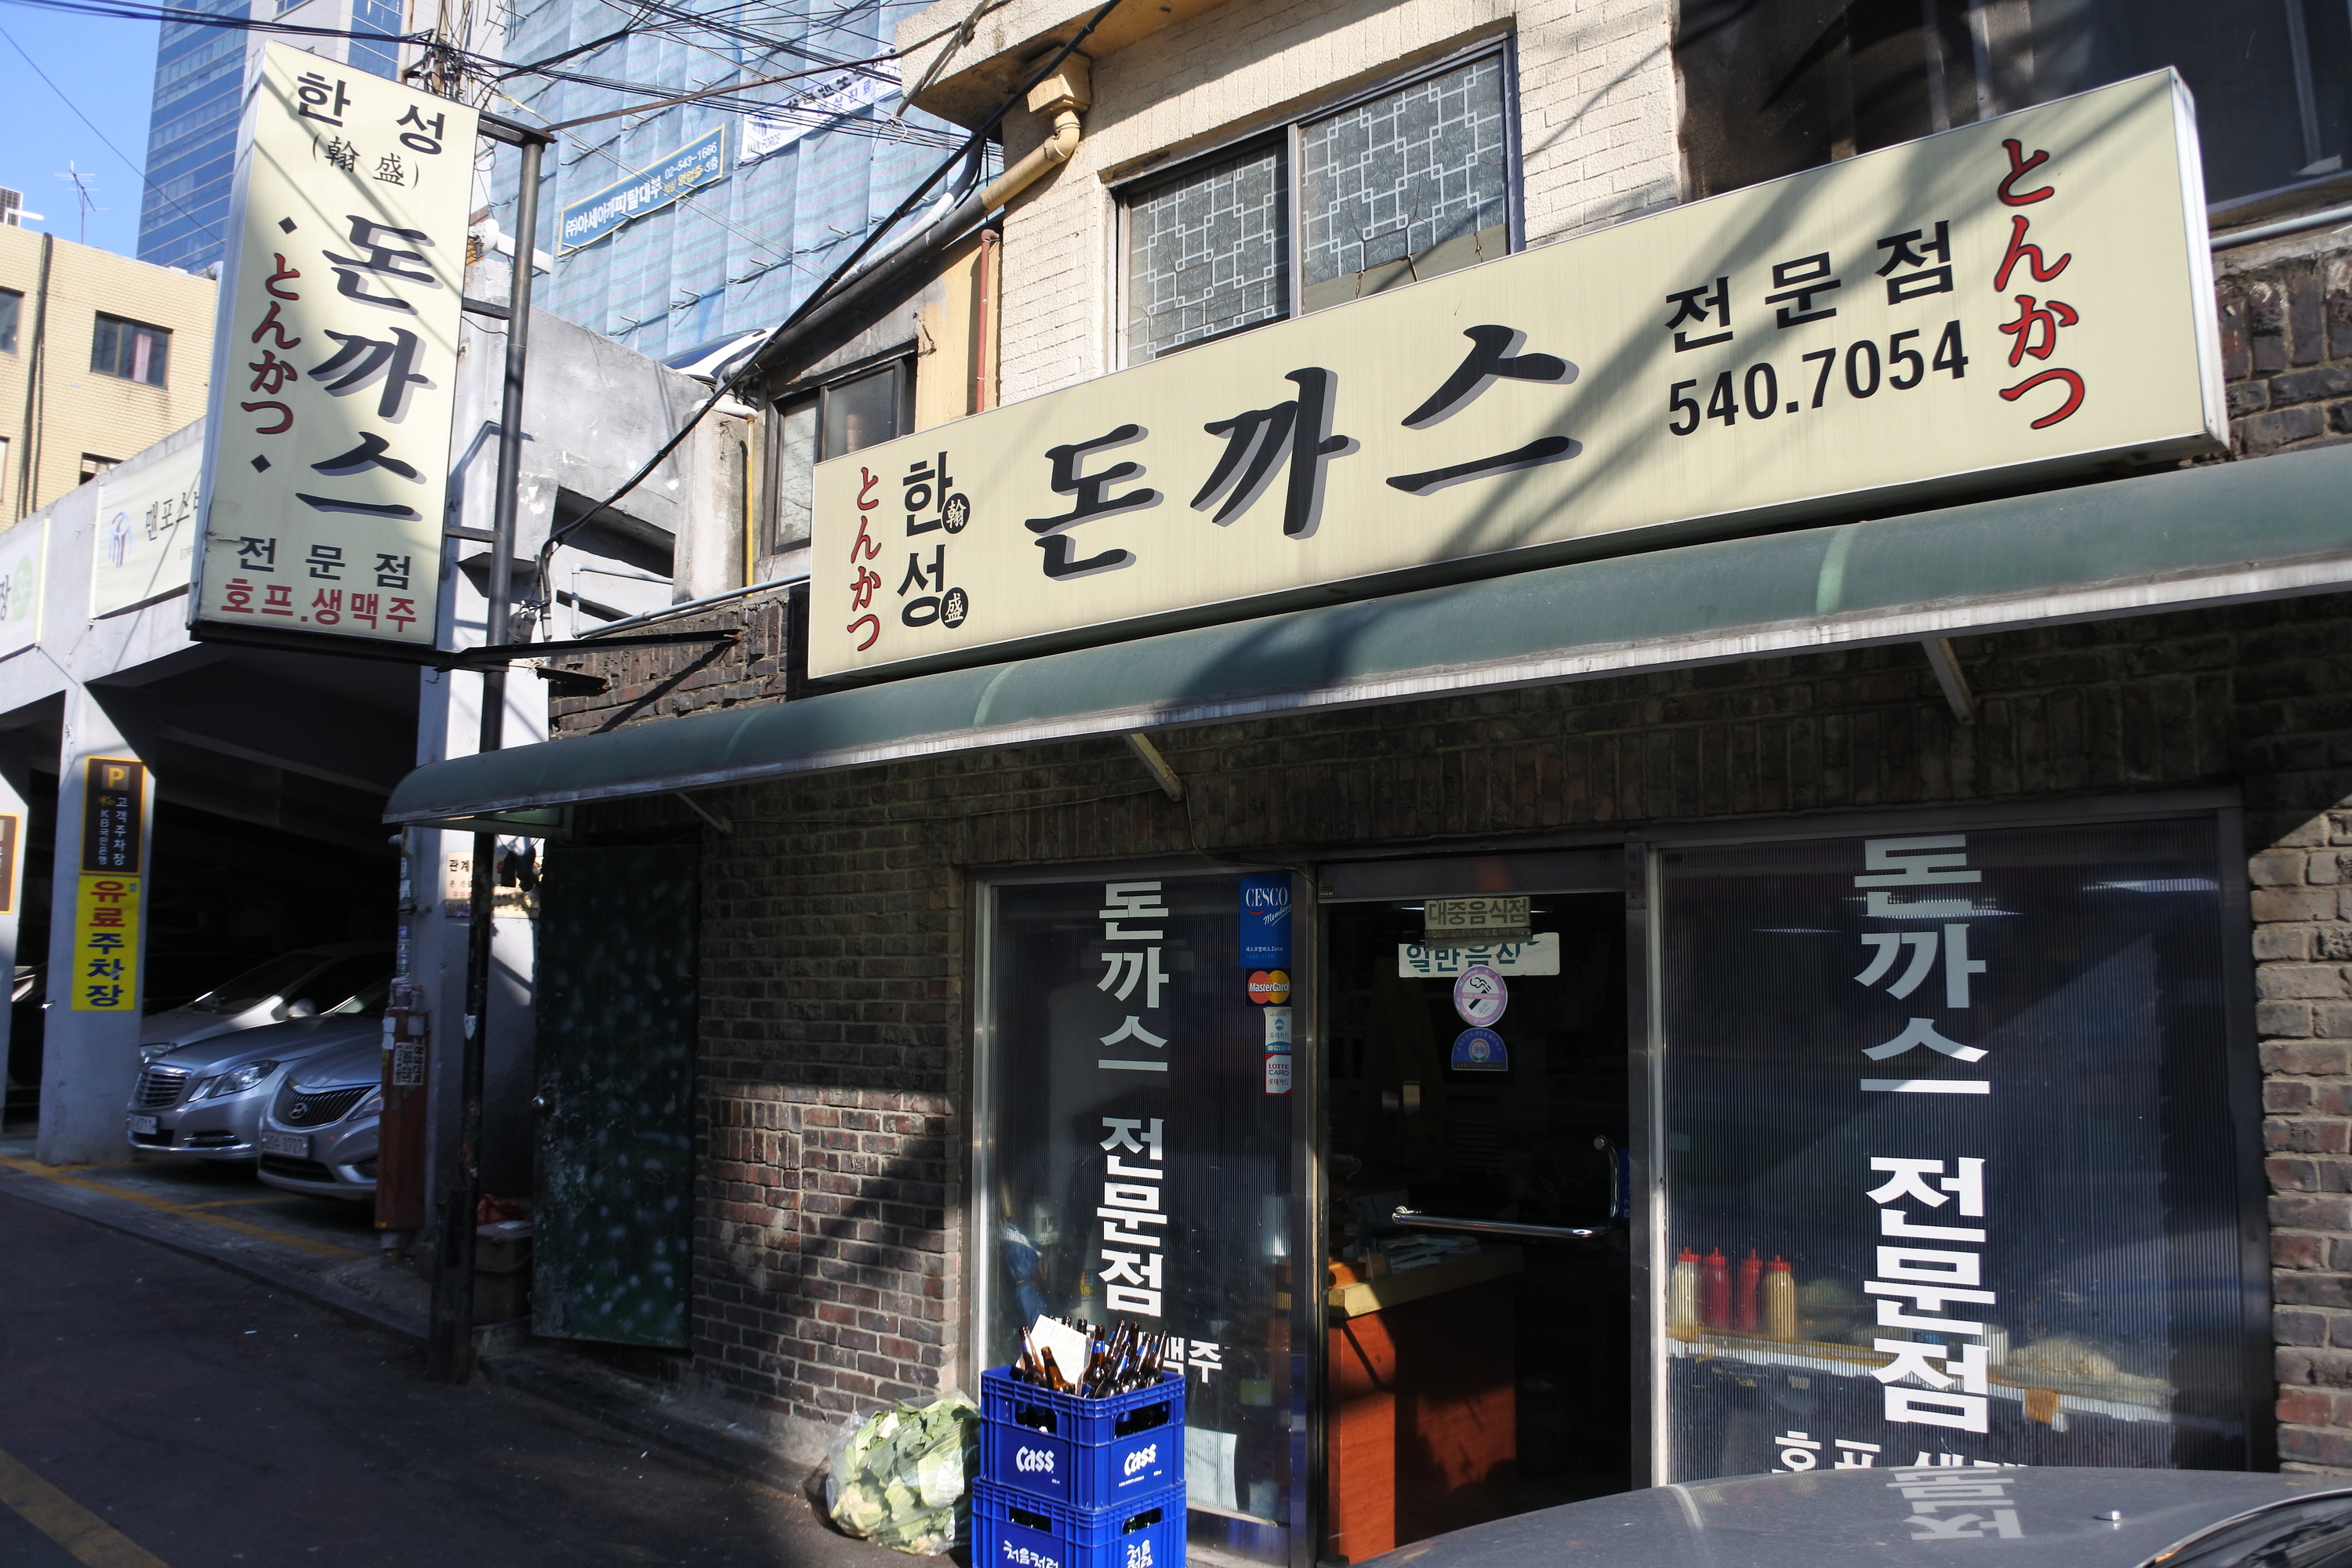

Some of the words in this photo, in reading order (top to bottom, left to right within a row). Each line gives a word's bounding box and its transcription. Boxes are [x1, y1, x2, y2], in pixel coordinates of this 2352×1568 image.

[296, 71, 446, 155] 한성
[1664, 220, 1955, 354] 전문점
[1993, 138, 2085, 430] とんかつ
[241, 252, 302, 436] とんかつ
[296, 214, 444, 523] 돈까스
[1668, 319, 1969, 437] 540.7054
[1024, 324, 1584, 582] 돈까스
[237, 536, 412, 590] 전문점
[847, 466, 882, 652] とんかつ
[897, 451, 953, 628] 한성
[107, 767, 125, 788] P
[113, 797, 129, 866] 고객주차장
[1245, 887, 1288, 908] CESCO
[1263, 903, 1292, 925] Members
[1428, 898, 1527, 926] 대중음식점
[1097, 880, 1170, 1072] 돈까스
[1248, 982, 1290, 993] MasterCard
[1406, 941, 1541, 974] 일반음식
[1853, 833, 1991, 1094] 돈까스
[1097, 1116, 1168, 1318] 전문점
[1864, 1156, 1996, 1435] 전문점
[1016, 1445, 1054, 1473] Cass
[1123, 1443, 1157, 1476] Cass
